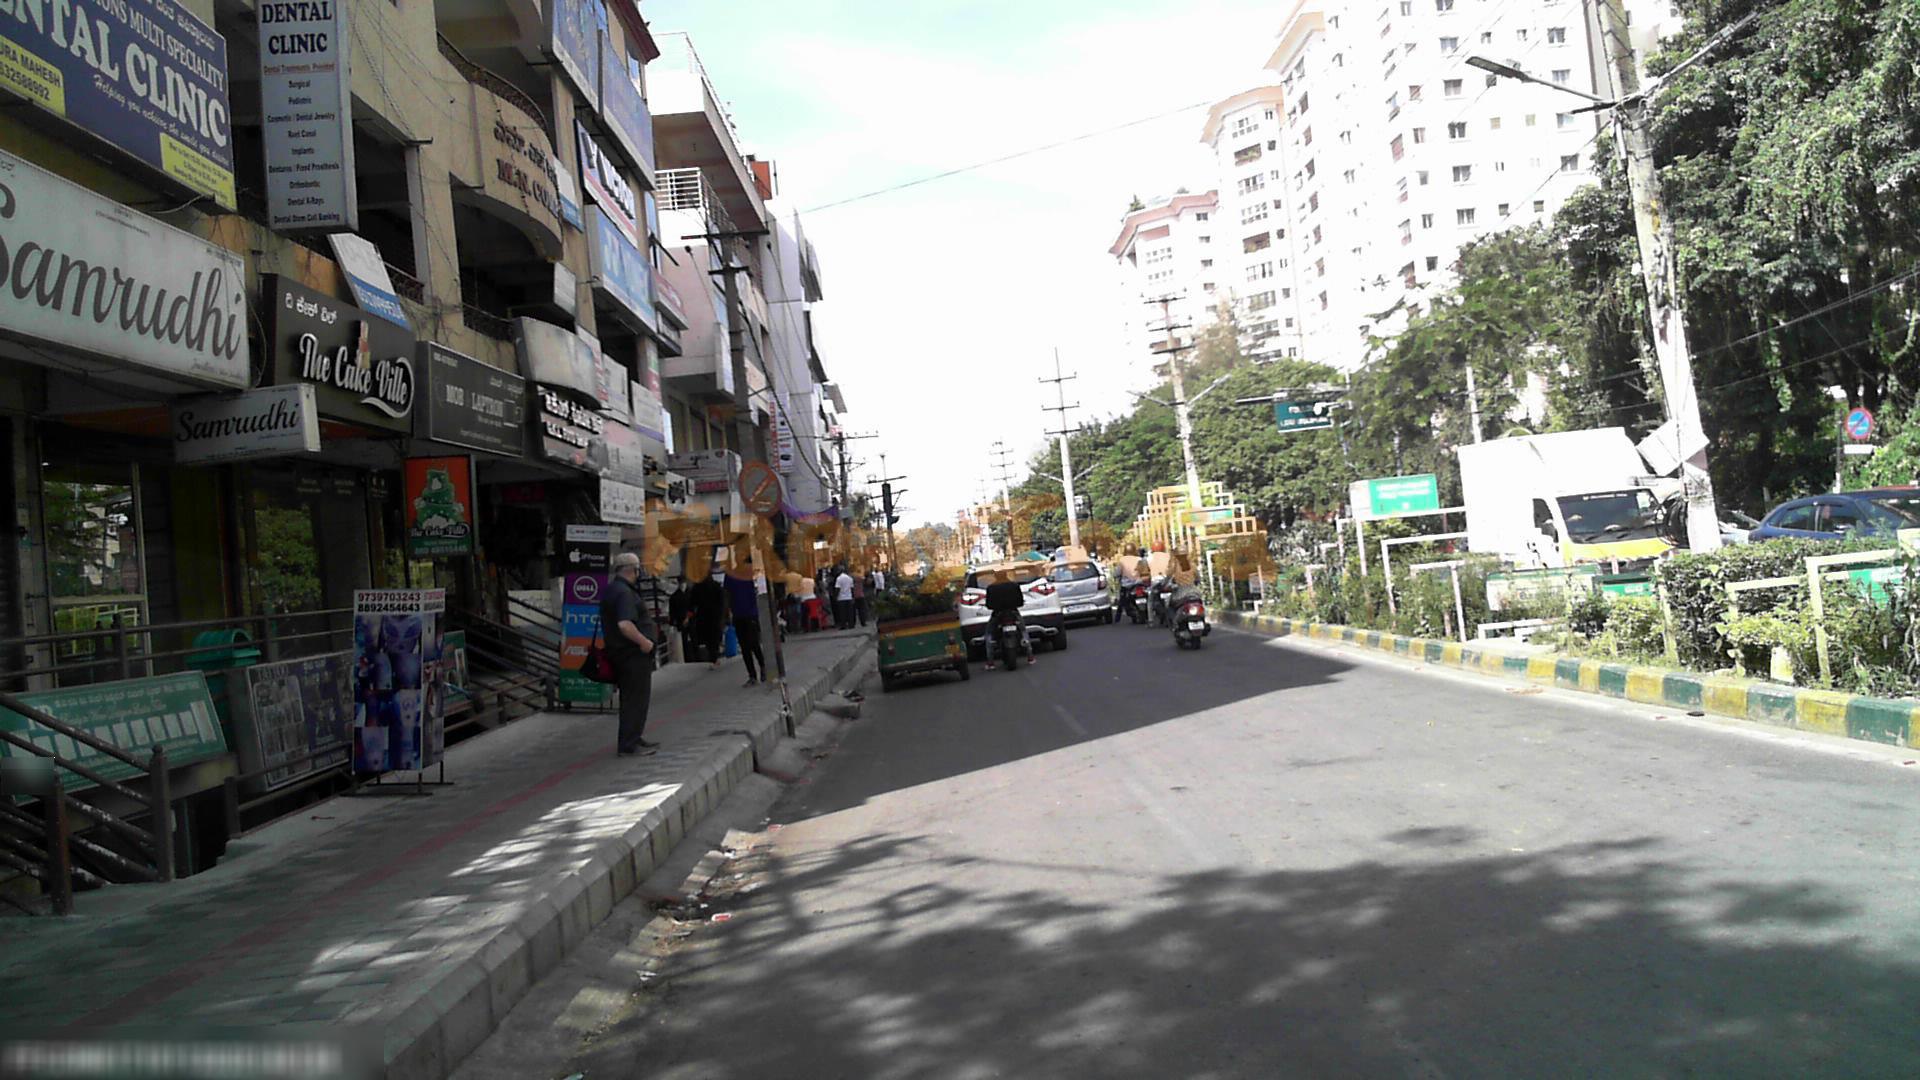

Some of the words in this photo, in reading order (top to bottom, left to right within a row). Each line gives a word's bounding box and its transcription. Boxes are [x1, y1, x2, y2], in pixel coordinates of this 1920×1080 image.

[261, 1, 332, 23] DENTAL
[268, 33, 328, 55] CLINIC
[0, 0, 119, 81] NTAL
[126, 43, 227, 147] CLINIC
[129, 8, 165, 51] MULTI
[166, 34, 224, 92] SPECIALITY
[0, 182, 241, 361] amrudhi
[300, 333, 331, 383] The
[335, 346, 371, 395] Cake
[375, 356, 413, 407] Ville
[176, 398, 300, 444] Samrudhi
